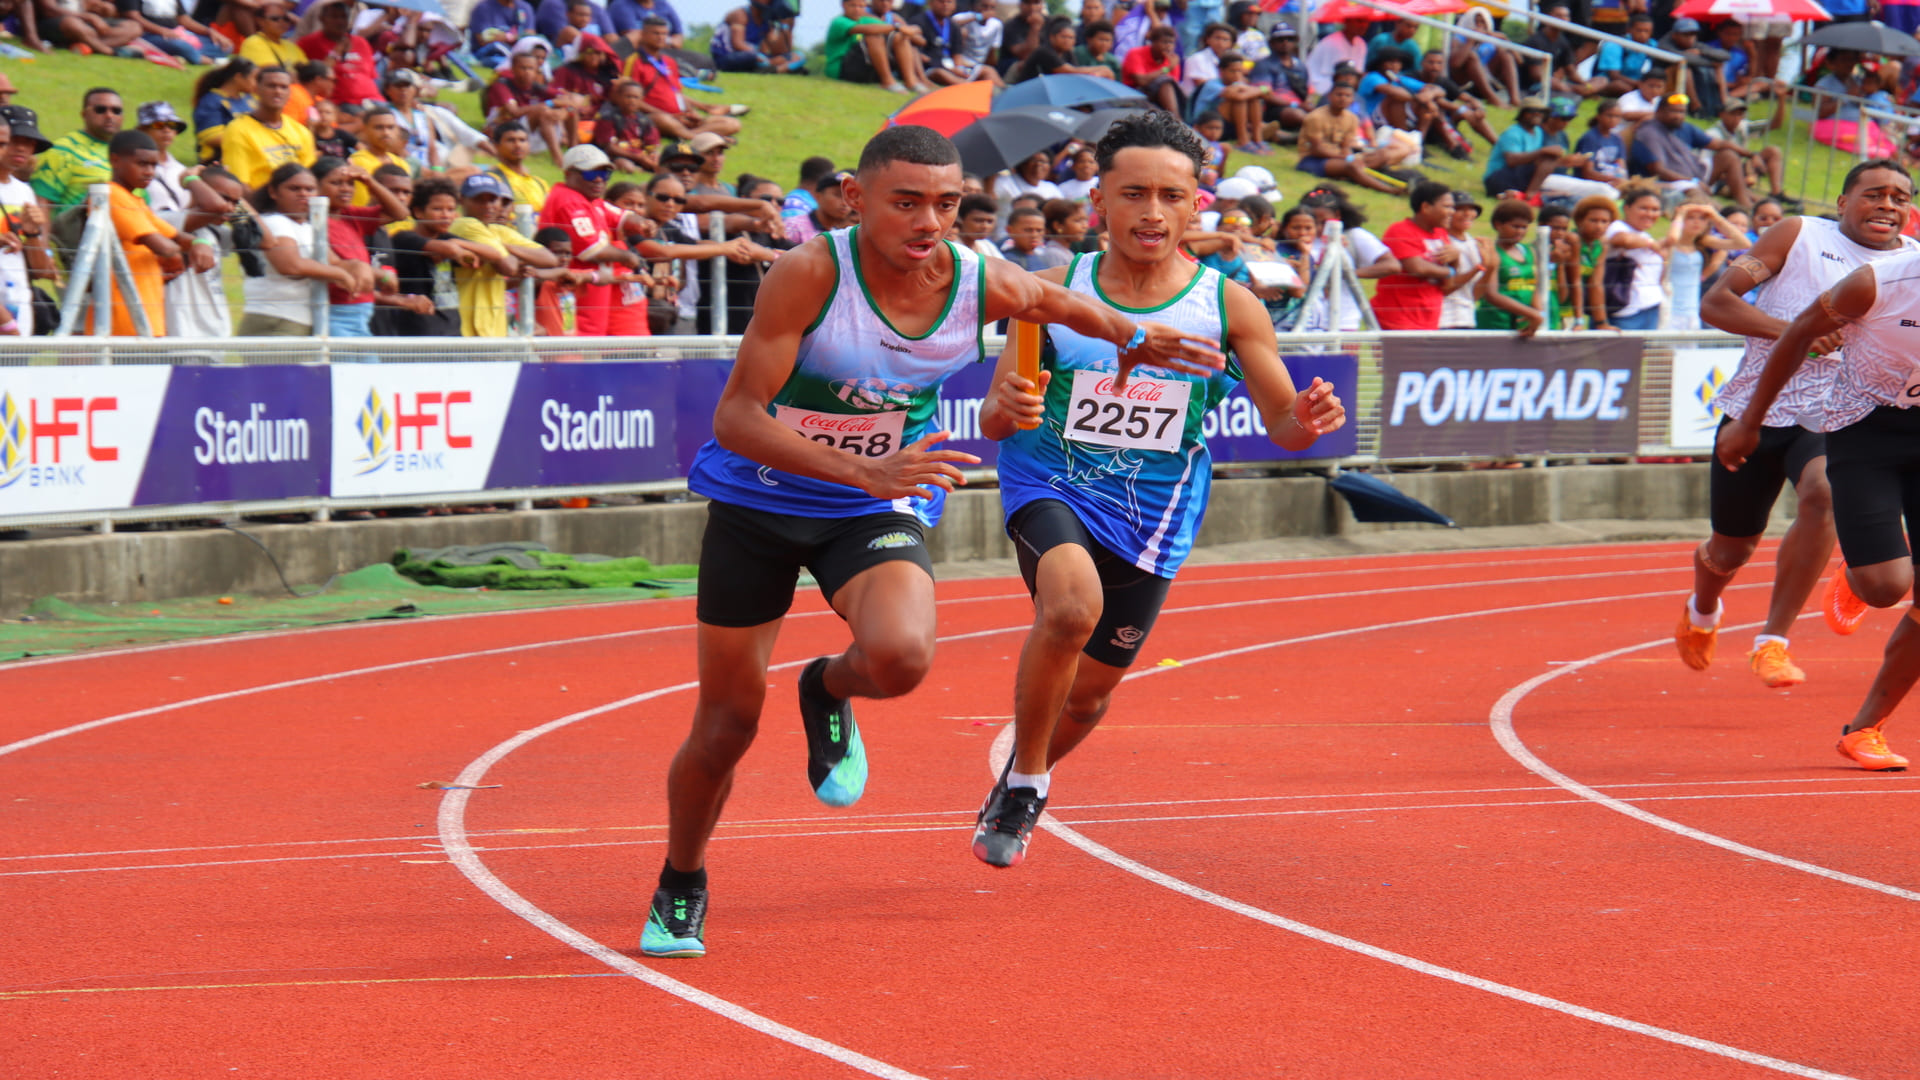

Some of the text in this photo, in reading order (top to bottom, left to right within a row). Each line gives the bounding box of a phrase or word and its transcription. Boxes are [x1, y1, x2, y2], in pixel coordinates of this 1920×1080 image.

[1900, 319, 1920, 328] BL
[1094, 377, 1168, 402] Co-Cola
[1390, 367, 1631, 426] POWERADE
[30, 396, 118, 464] HFC
[194, 402, 309, 465] Stadium
[394, 390, 472, 451] HFC
[540, 395, 655, 452] Stadium
[800, 413, 880, 432] Coca-Cola
[1073, 398, 1178, 439] 2257
[794, 429, 891, 457] 58
[29, 464, 85, 487] BANK
[394, 451, 444, 472] BANK
